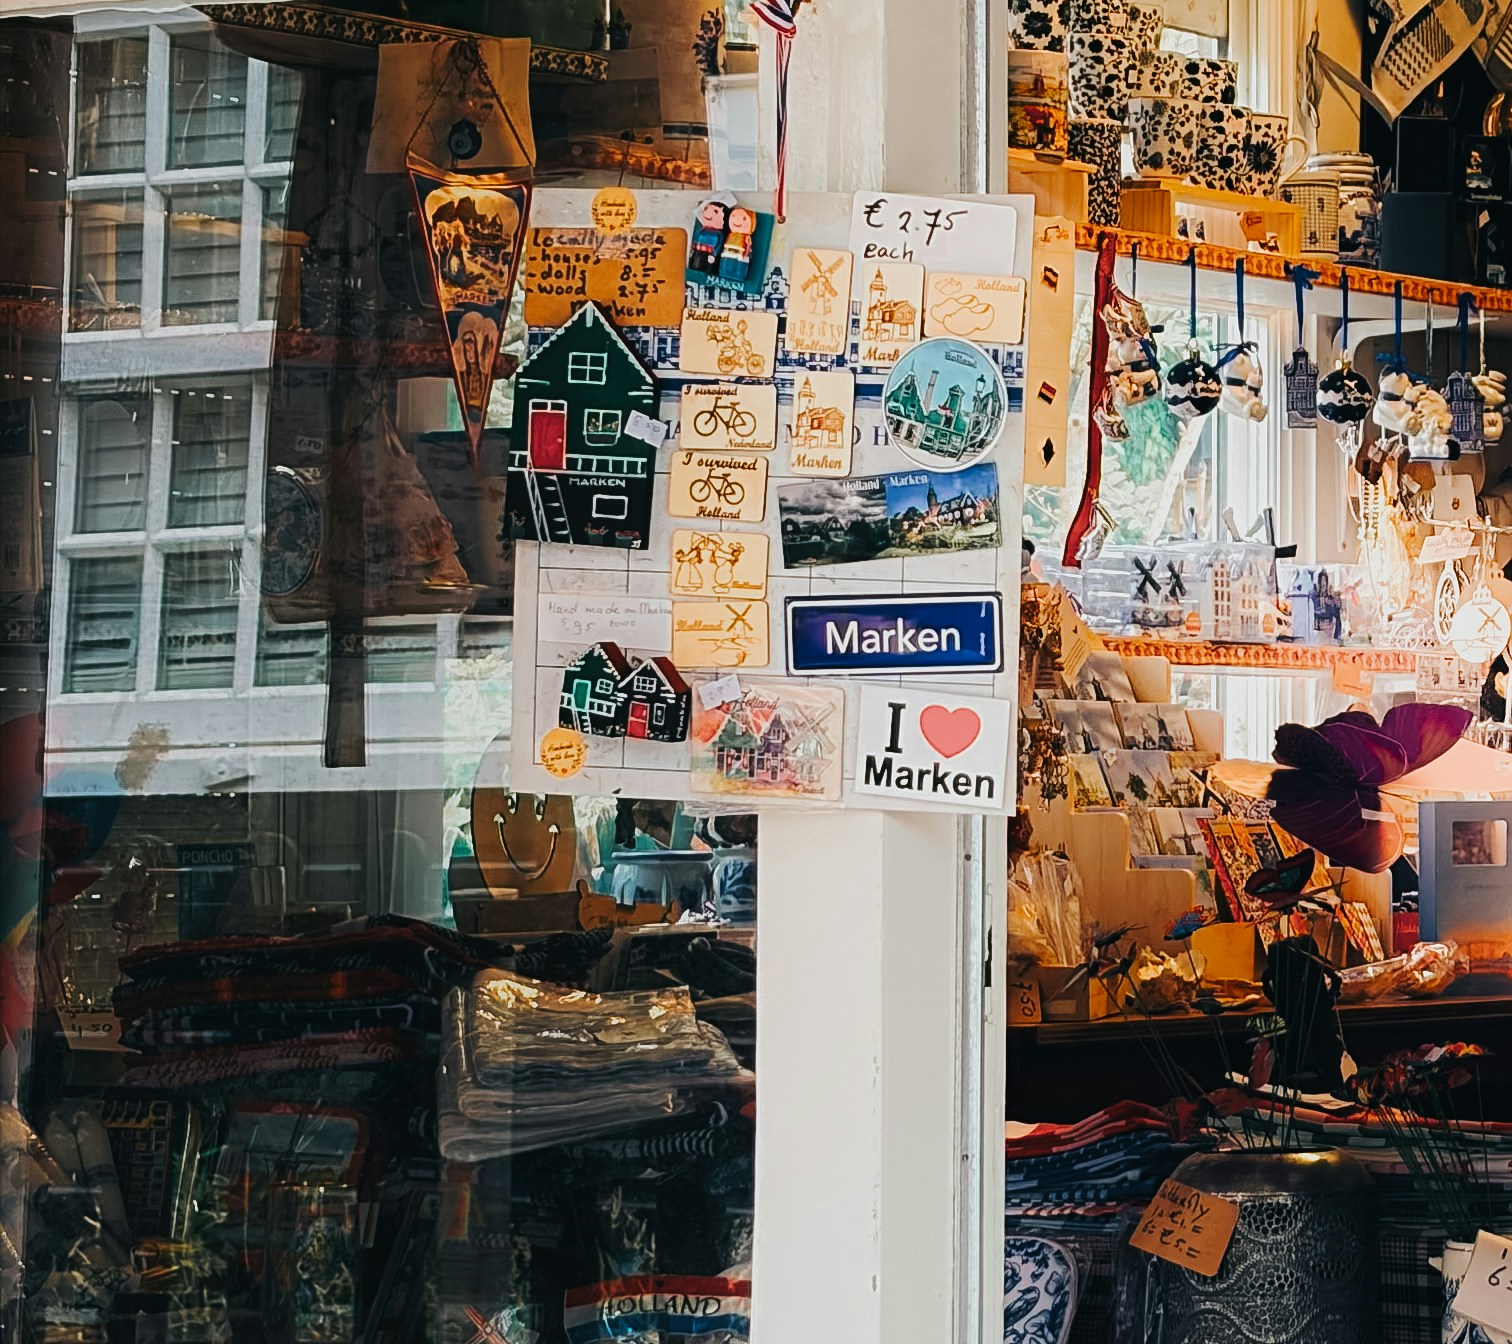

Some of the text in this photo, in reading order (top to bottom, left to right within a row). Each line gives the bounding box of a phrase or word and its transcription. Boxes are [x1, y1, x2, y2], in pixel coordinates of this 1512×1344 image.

[898, 208, 969, 246] 2.75
[863, 241, 914, 262] each
[541, 265, 587, 281] dolls
[537, 284, 587, 296] wood
[973, 278, 1021, 293] Holland
[685, 308, 730, 323] Holland
[682, 452, 758, 472] I survived
[790, 453, 843, 470] Marken
[568, 477, 627, 488] MARKEN
[696, 506, 742, 520] Holland
[825, 617, 961, 655] Marken
[884, 701, 907, 754] I
[863, 753, 996, 800] Marken
